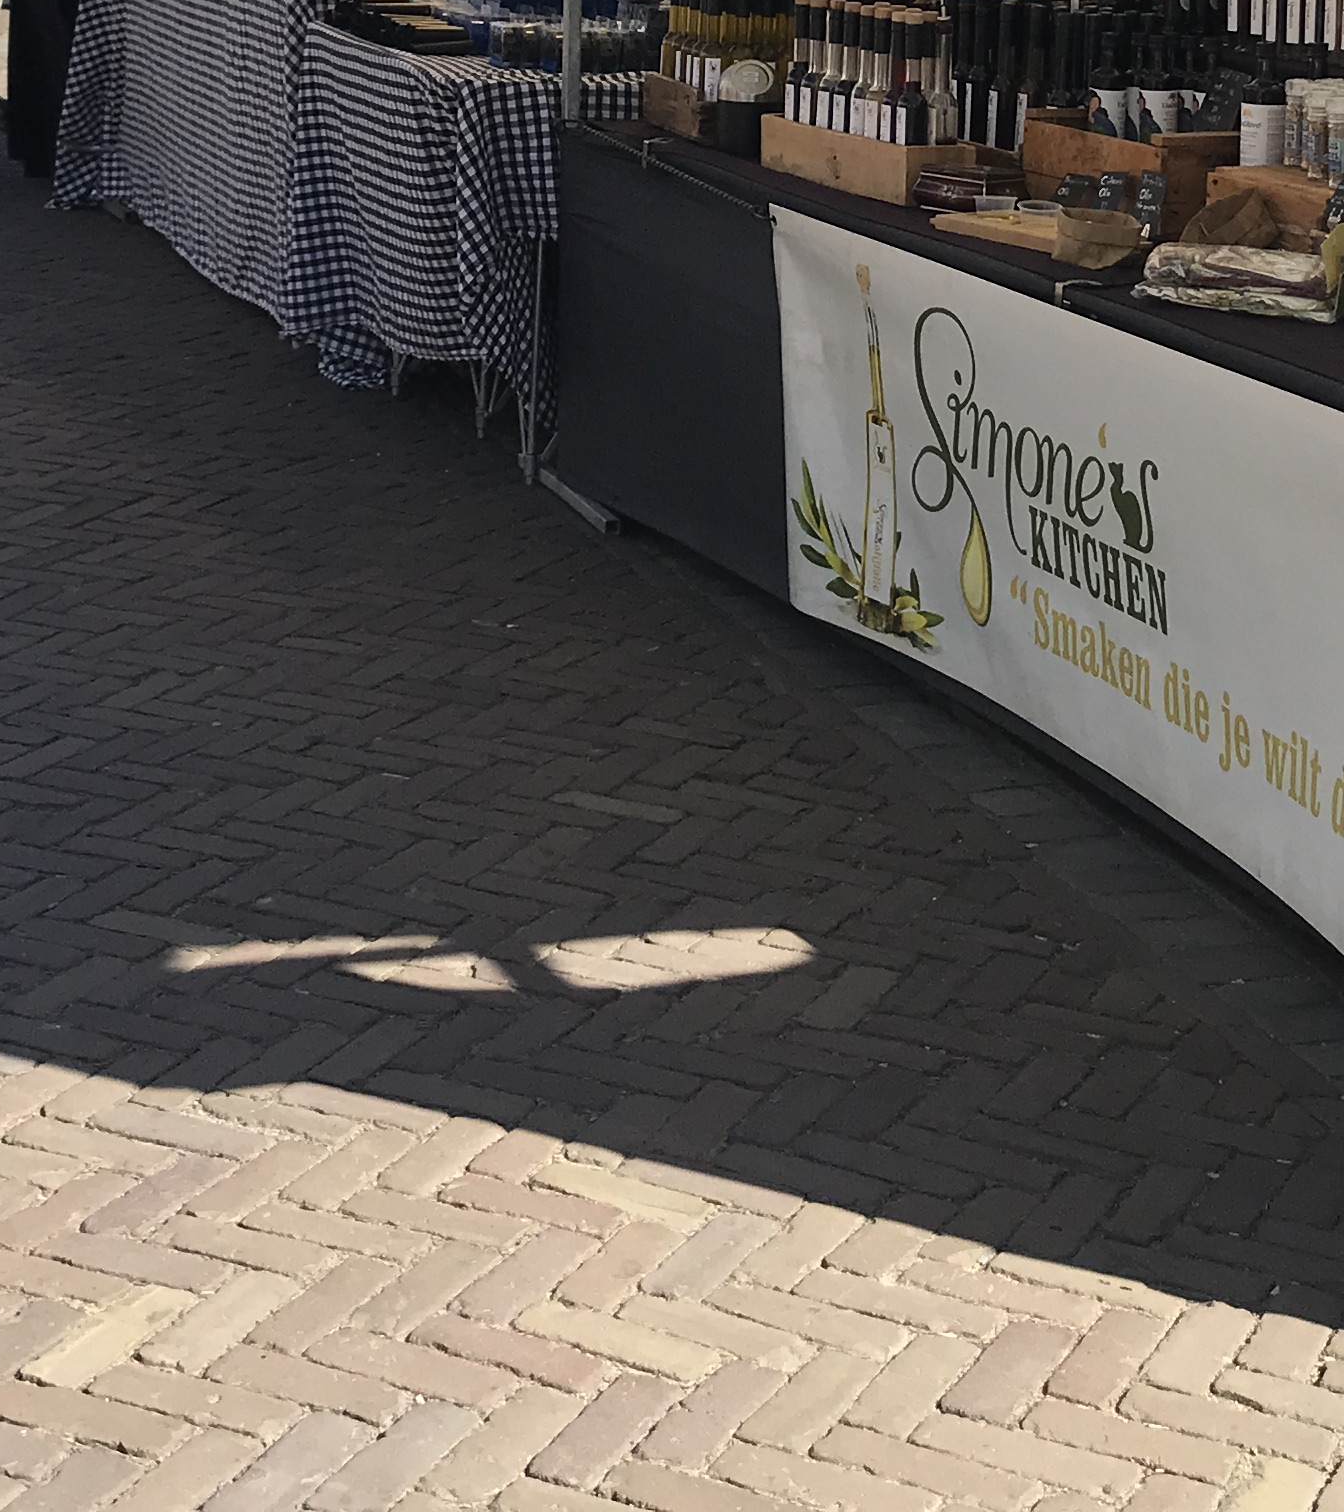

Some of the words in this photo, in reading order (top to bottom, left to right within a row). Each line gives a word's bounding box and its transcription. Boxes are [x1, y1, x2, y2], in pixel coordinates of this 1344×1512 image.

[1029, 505, 1168, 635] KITCHEN
[1010, 574, 1152, 709] “Smaken
[1163, 661, 1210, 744] die
[1218, 691, 1252, 773] je
[1262, 727, 1323, 818] wilt
